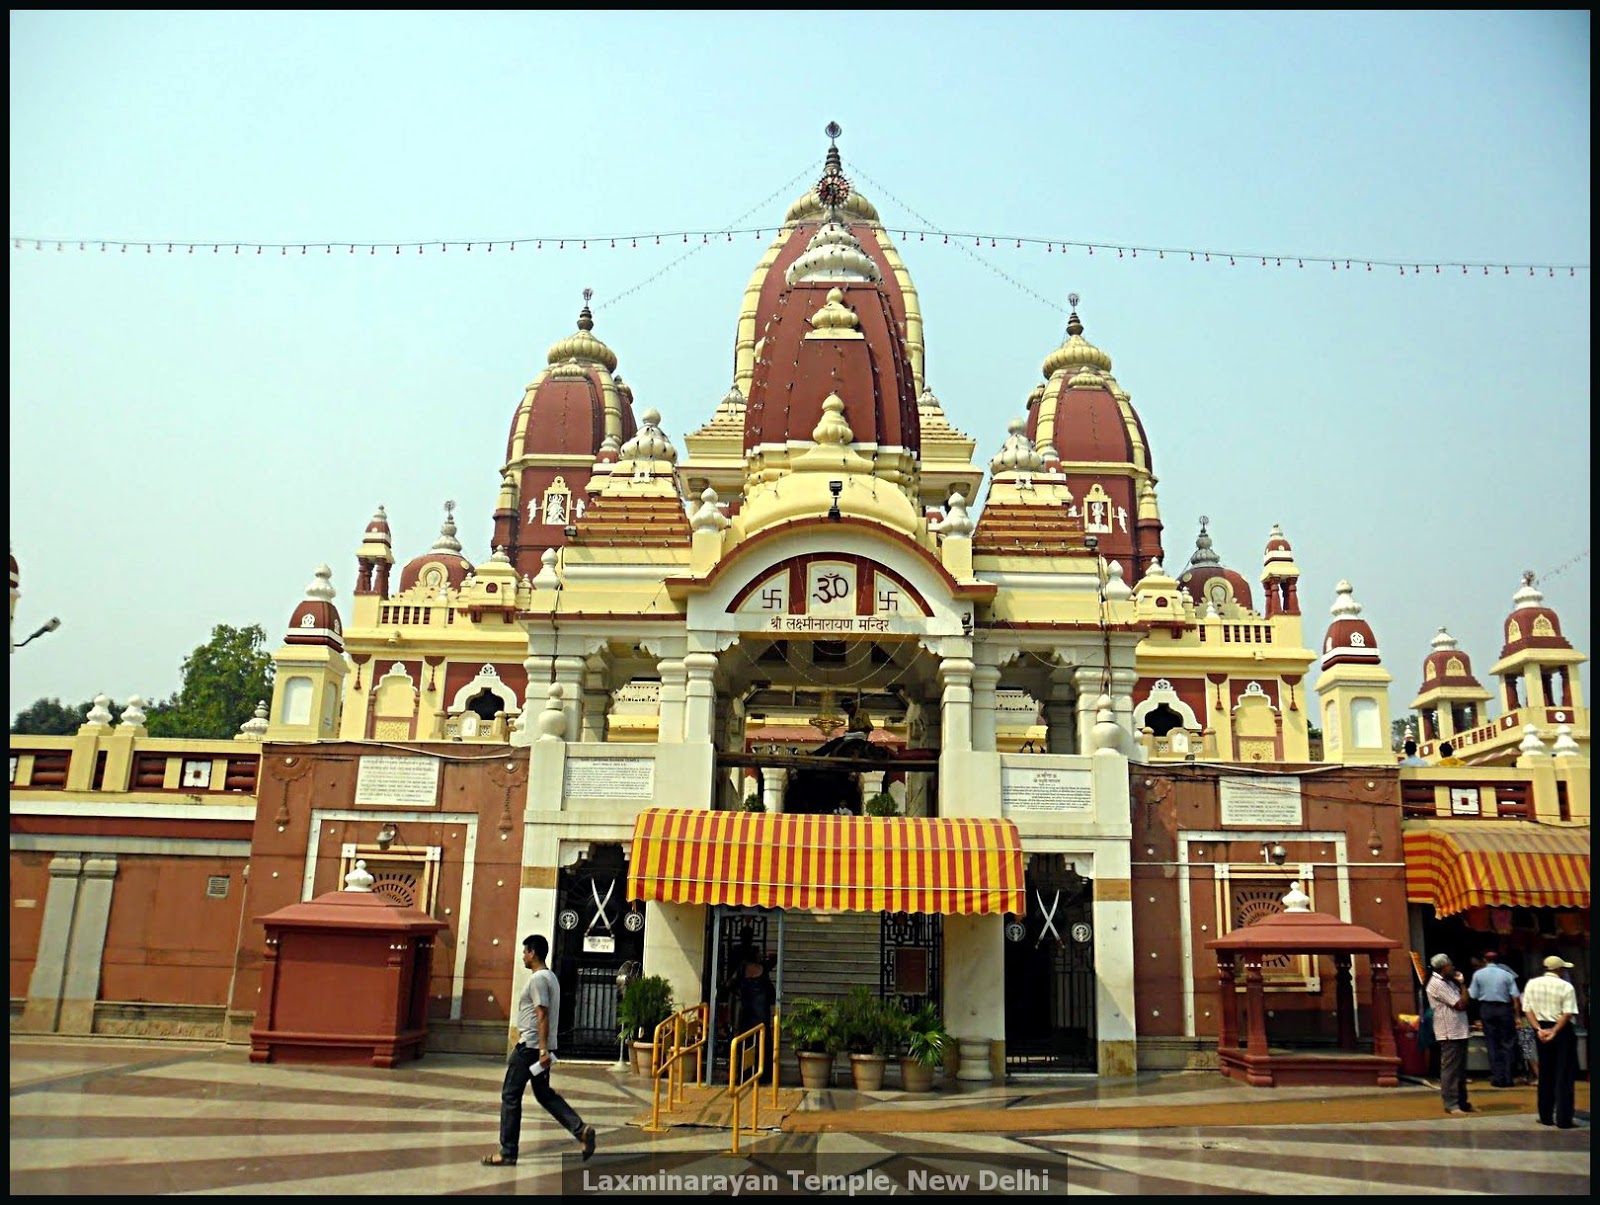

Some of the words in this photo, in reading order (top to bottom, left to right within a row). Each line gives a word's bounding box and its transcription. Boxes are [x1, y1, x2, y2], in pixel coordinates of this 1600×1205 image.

[770, 616, 782, 631] श्री
[786, 616, 854, 631] लक्ष्मीनारायण
[858, 617, 889, 632] मन्दिर
